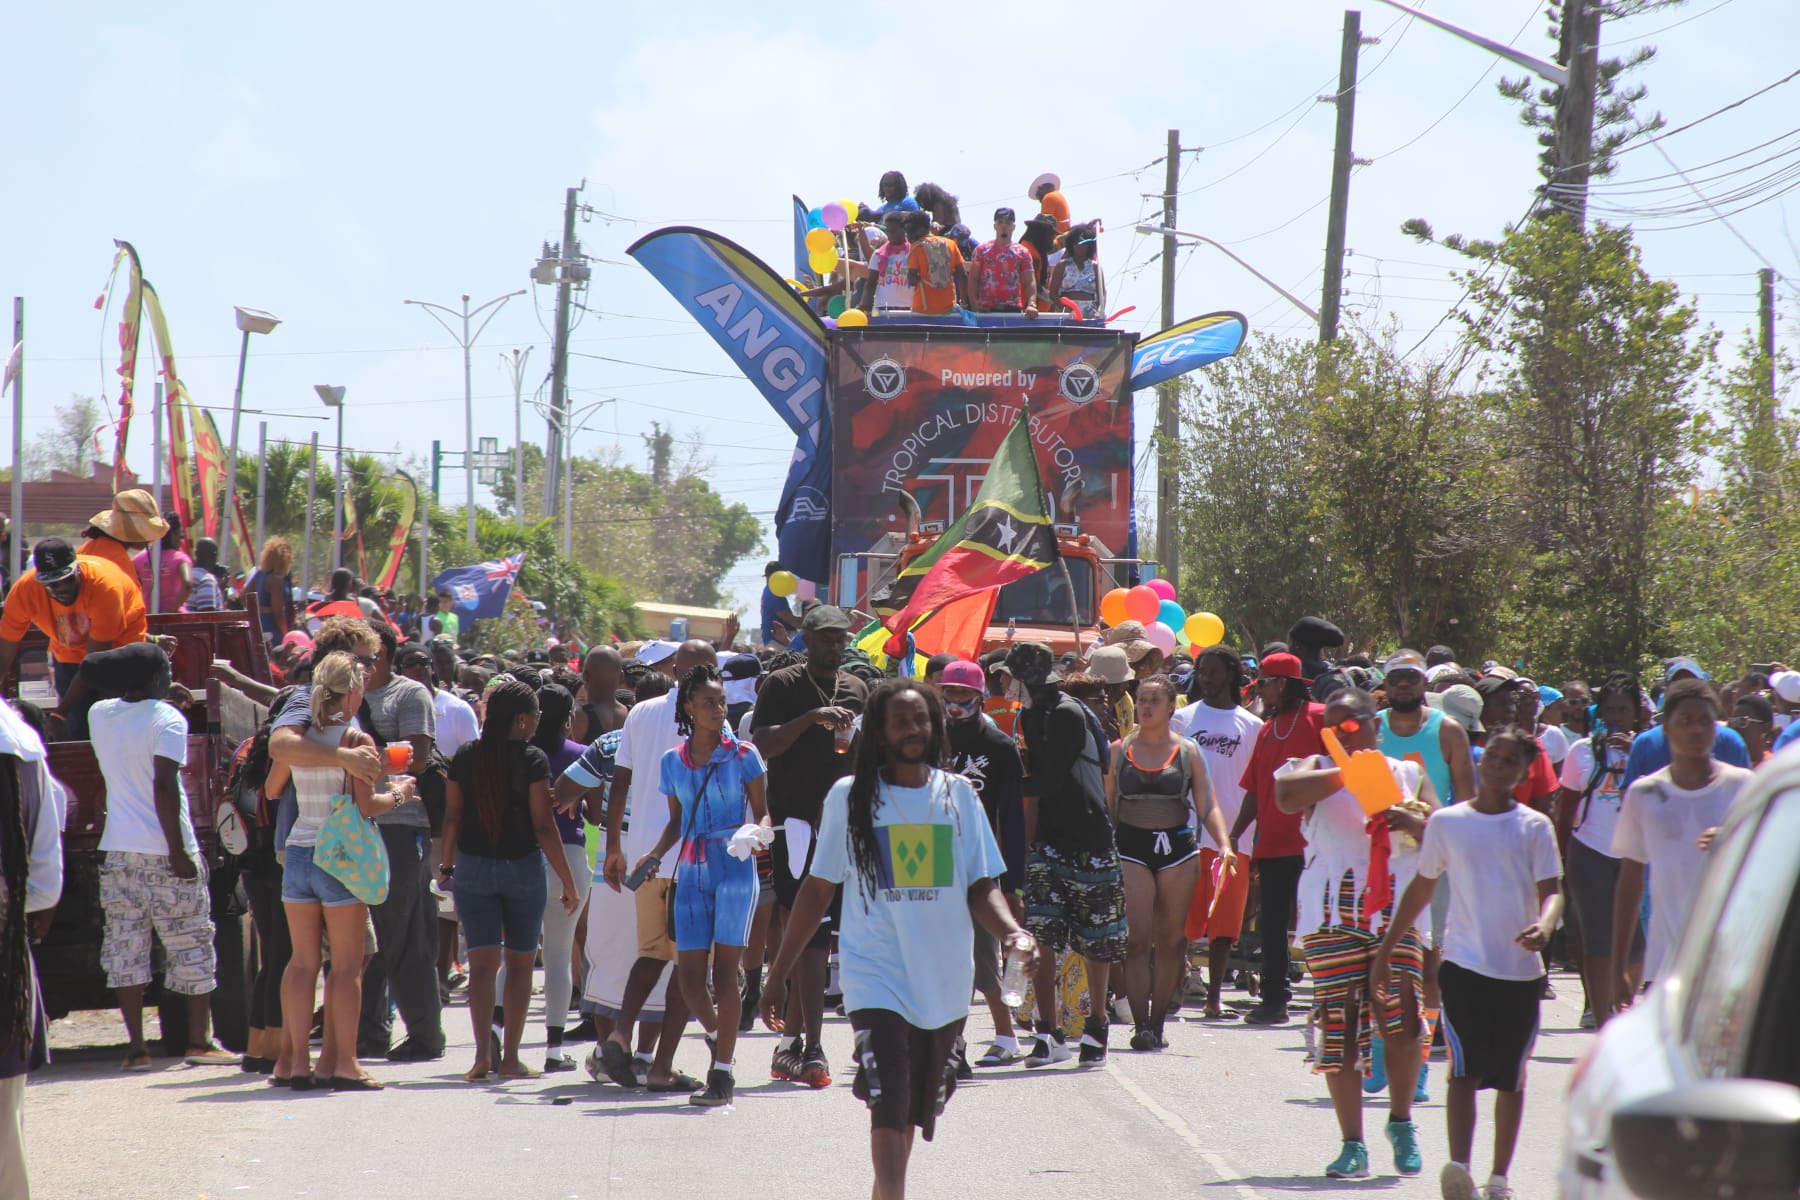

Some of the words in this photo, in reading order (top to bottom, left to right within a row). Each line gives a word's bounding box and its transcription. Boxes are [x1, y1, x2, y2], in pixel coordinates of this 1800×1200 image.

[941, 368, 1012, 387] Powered
[1017, 368, 1037, 390] by
[881, 409, 961, 493] TROPICAL
[966, 403, 1086, 489] DISTRBUTOR
[907, 888, 940, 902] VINCY
